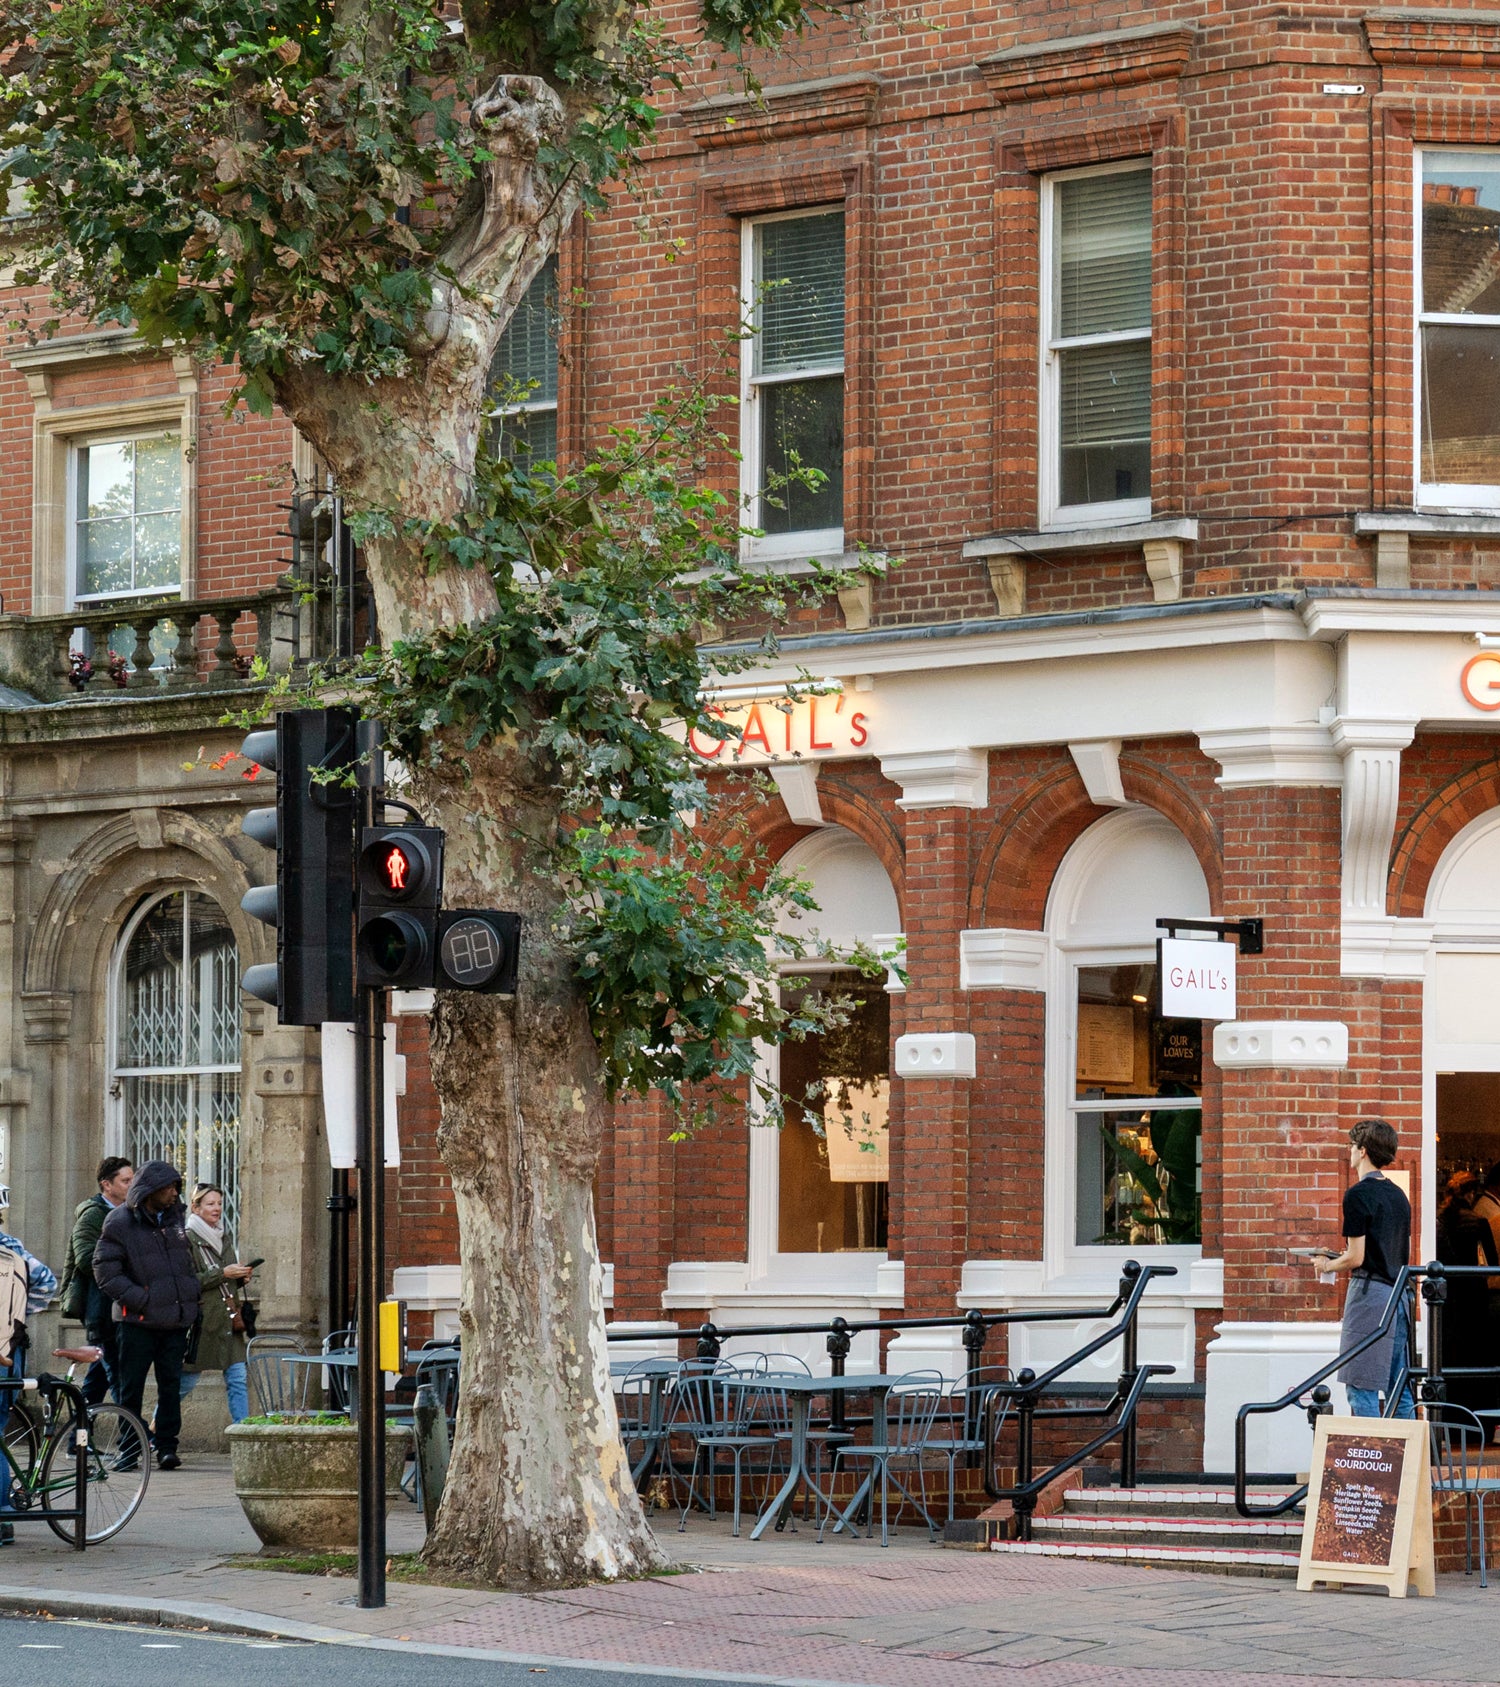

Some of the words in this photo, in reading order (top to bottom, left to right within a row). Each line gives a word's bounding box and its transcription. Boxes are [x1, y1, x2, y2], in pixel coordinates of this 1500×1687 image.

[1170, 967, 1227, 990] GAIL's
[1169, 1034, 1188, 1047] OUR
[1163, 1047, 1194, 1059] LOAVES
[1347, 1447, 1383, 1460] SEEDED
[1334, 1458, 1393, 1473] SOURDOUGH
